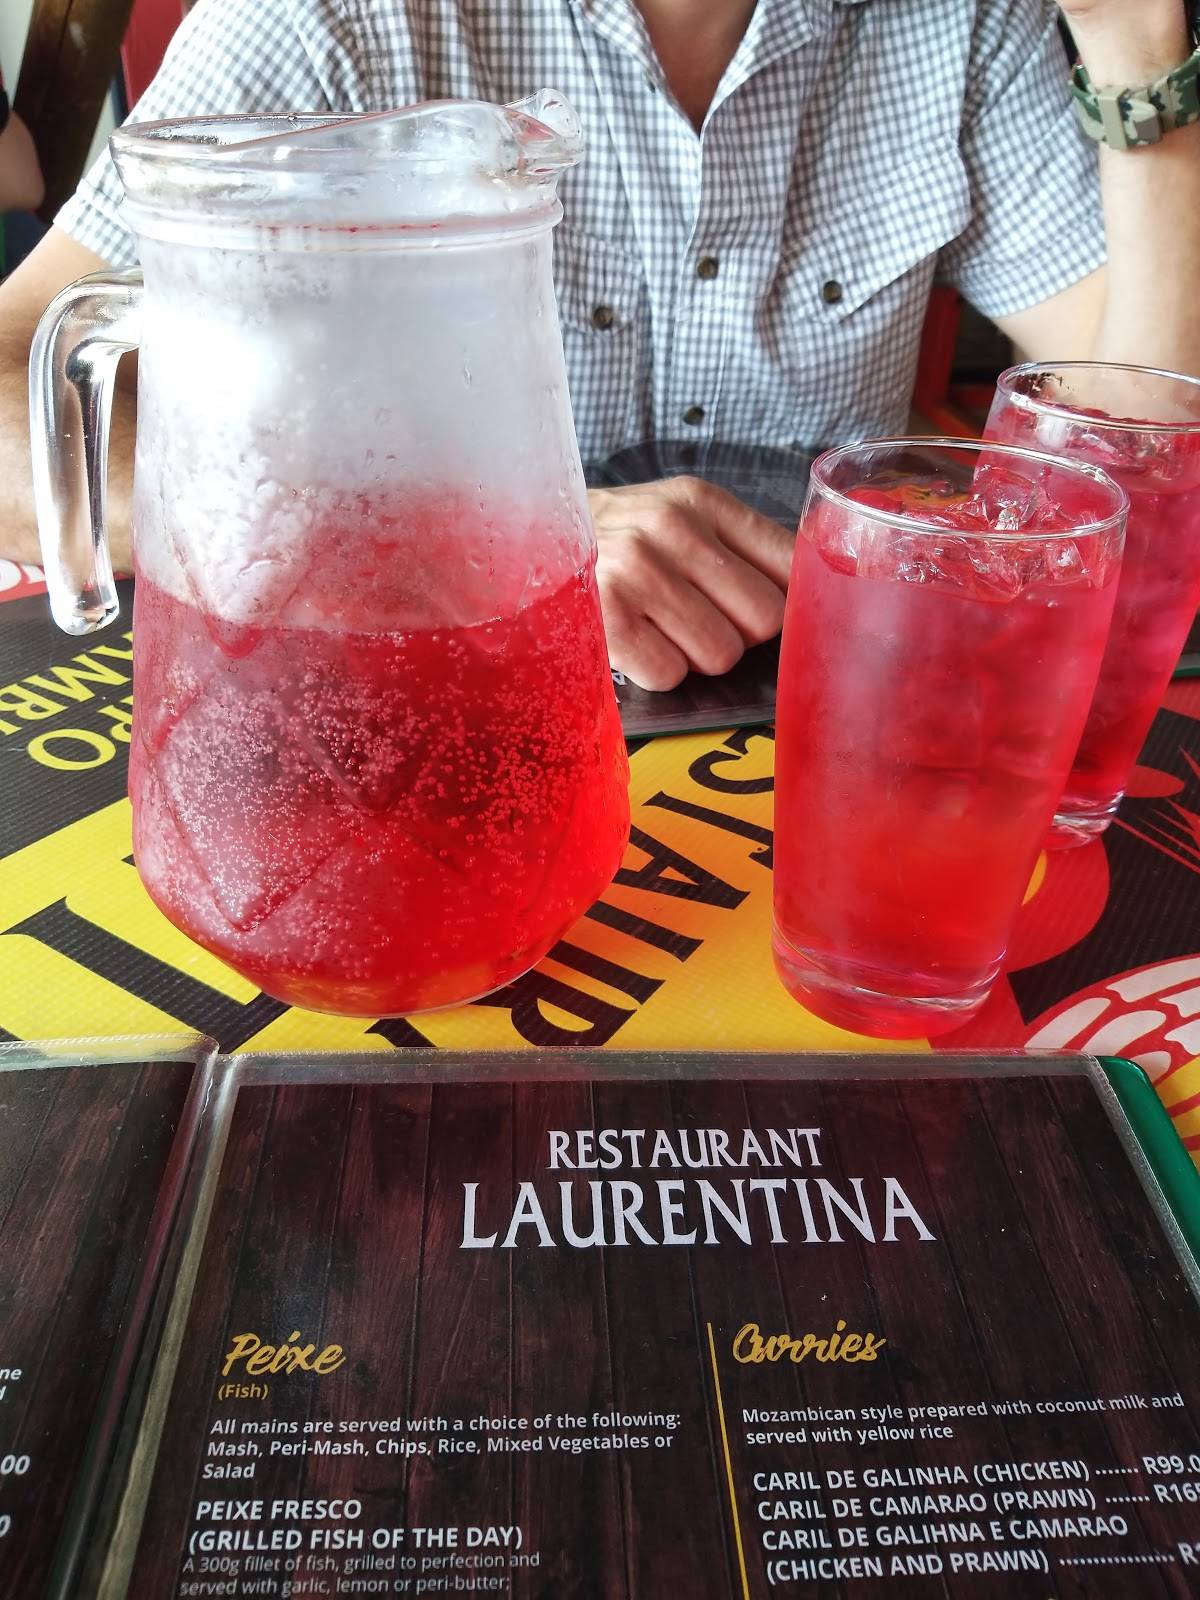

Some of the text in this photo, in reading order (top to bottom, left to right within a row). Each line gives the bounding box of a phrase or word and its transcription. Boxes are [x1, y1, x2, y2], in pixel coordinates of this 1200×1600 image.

[547, 1127, 823, 1170] RESTAURANT
[459, 1176, 938, 1249] LAURENTINA
[222, 1330, 347, 1377] Peixe
[732, 1319, 887, 1364] Curries
[217, 1384, 270, 1401] (Fish)
[742, 1392, 1185, 1423] Mozambican style prepared with coconut milk and
[210, 1410, 681, 1434] All mains are served with a choice of the following:
[746, 1424, 954, 1445] served with yellow rice
[207, 1432, 674, 1458] Mash, Peri-Mash, Chips, Rice, Mixed Vegetables or
[202, 1462, 256, 1480] Salad
[753, 1471, 821, 1492] CARIL
[826, 1469, 857, 1489] DE
[862, 1466, 969, 1488] GALINHA
[973, 1460, 1090, 1486] (CHICKEN)
[195, 1499, 362, 1521] PEIXE FRESCO
[757, 1500, 826, 1521] CARIL
[832, 1499, 863, 1518] DE
[869, 1492, 988, 1517] CAMARAO
[993, 1488, 1097, 1514] (PRAWN)
[189, 1526, 524, 1555] (GRILLED FISH OF THE DAY)
[762, 1515, 1129, 1550] CARIL DE GALIHNA E CAMARAO
[182, 1551, 541, 1575] A 300g fillet of fish, grilled to perfection and
[766, 1556, 883, 1585] (CHICKEN
[890, 1553, 943, 1576] AND
[949, 1549, 1050, 1574] PRAWN)
[180, 1576, 511, 1597] served with garlic, lemon or peri-butter;
